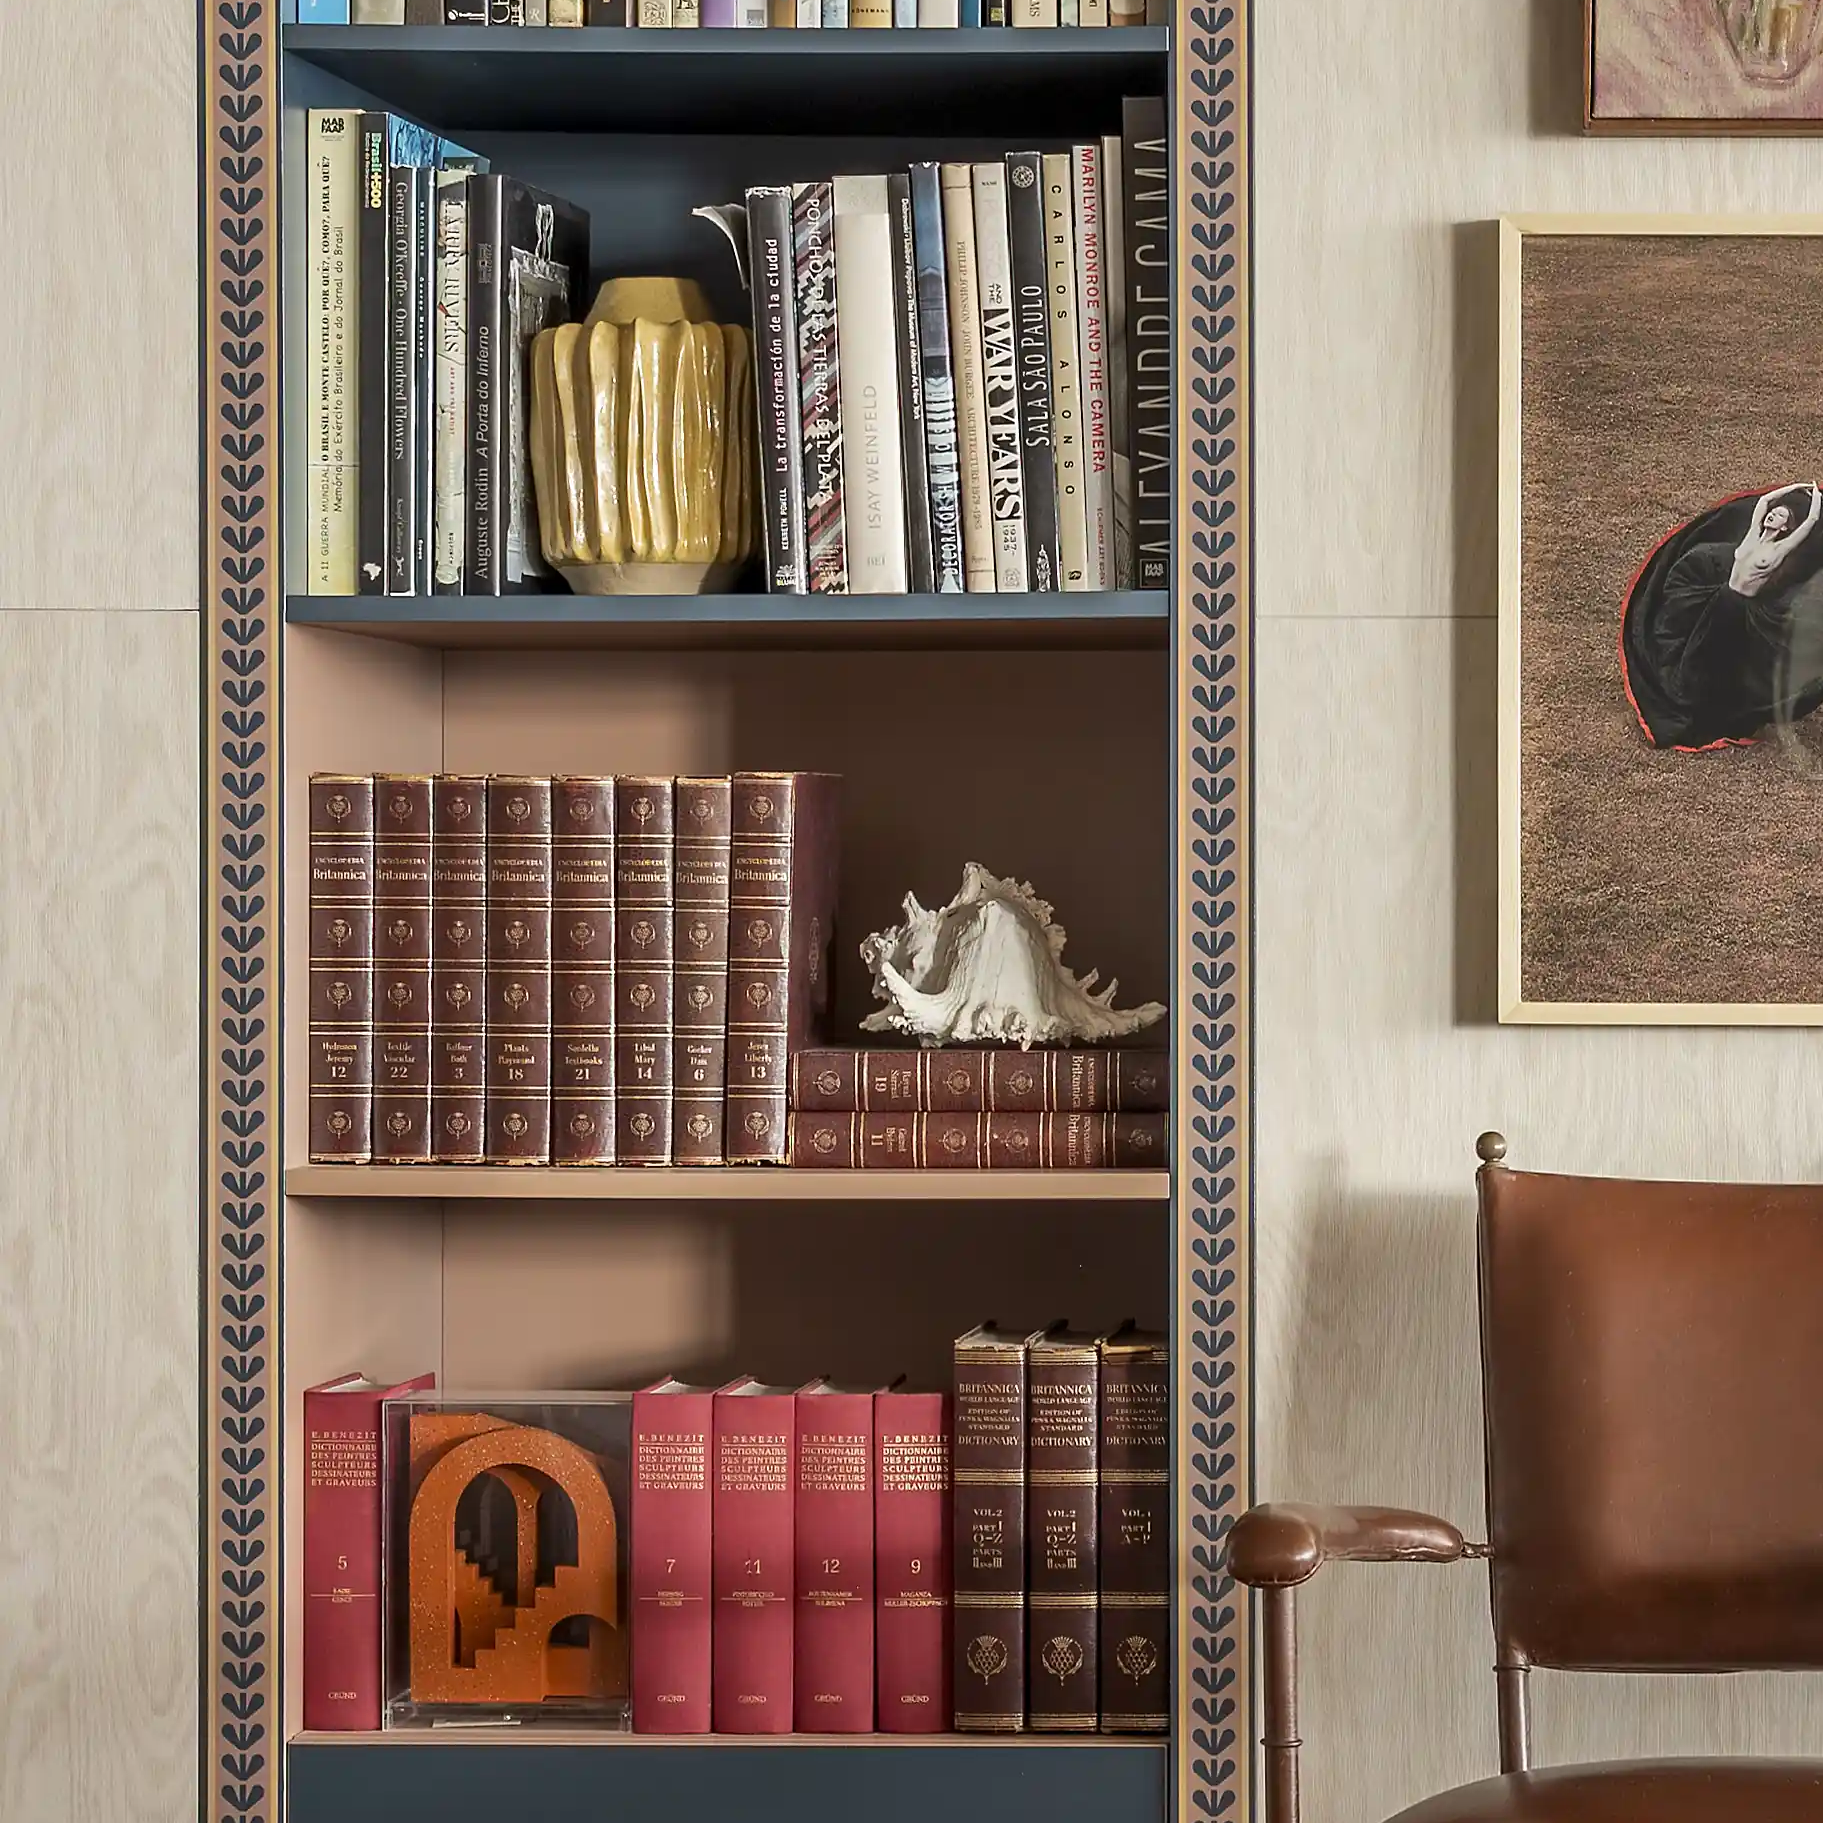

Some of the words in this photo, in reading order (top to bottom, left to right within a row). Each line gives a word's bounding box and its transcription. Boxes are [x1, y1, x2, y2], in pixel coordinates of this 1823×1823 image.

[1080, 148, 1096, 225] MARILYN
[393, 182, 407, 235] Georgia
[333, 227, 343, 256] Brasil
[334, 261, 343, 274] do
[766, 239, 780, 287] ciudad
[1084, 233, 1099, 309] MONROE
[334, 279, 343, 311] Jornal
[769, 293, 781, 309] la
[334, 316, 343, 328] do
[394, 309, 407, 336] One
[770, 315, 782, 332] de
[1021, 286, 1043, 348] PAULO
[1088, 317, 1101, 351] AND
[477, 326, 489, 376] Inferno
[983, 311, 1016, 393] WAR
[334, 345, 343, 394] Brasileiro
[394, 340, 407, 401] Hundred
[1022, 356, 1047, 390] SÃO
[1090, 358, 1103, 392] THE
[476, 380, 489, 399] do
[769, 339, 785, 450] transformación
[333, 398, 343, 444] Exército
[393, 406, 407, 459] Flowers
[476, 404, 489, 442] Porta
[1025, 397, 1050, 447] SALA
[1091, 399, 1106, 473] CAMERA
[334, 449, 343, 461] do
[476, 446, 489, 458] A
[776, 457, 787, 472] La
[987, 398, 1022, 518] YEARS
[333, 465, 343, 512] Memória
[474, 468, 489, 511] Rodin
[475, 518, 490, 579] Auguste
[331, 1067, 346, 1077] 12
[390, 1067, 407, 1078] 22
[509, 1068, 524, 1080] 18
[575, 1069, 590, 1080] 21
[750, 1066, 766, 1078] 13
[338, 1555, 348, 1570] 5
[666, 1558, 676, 1573] 7
[822, 1559, 840, 1573] 12
[911, 1559, 921, 1574] 9
